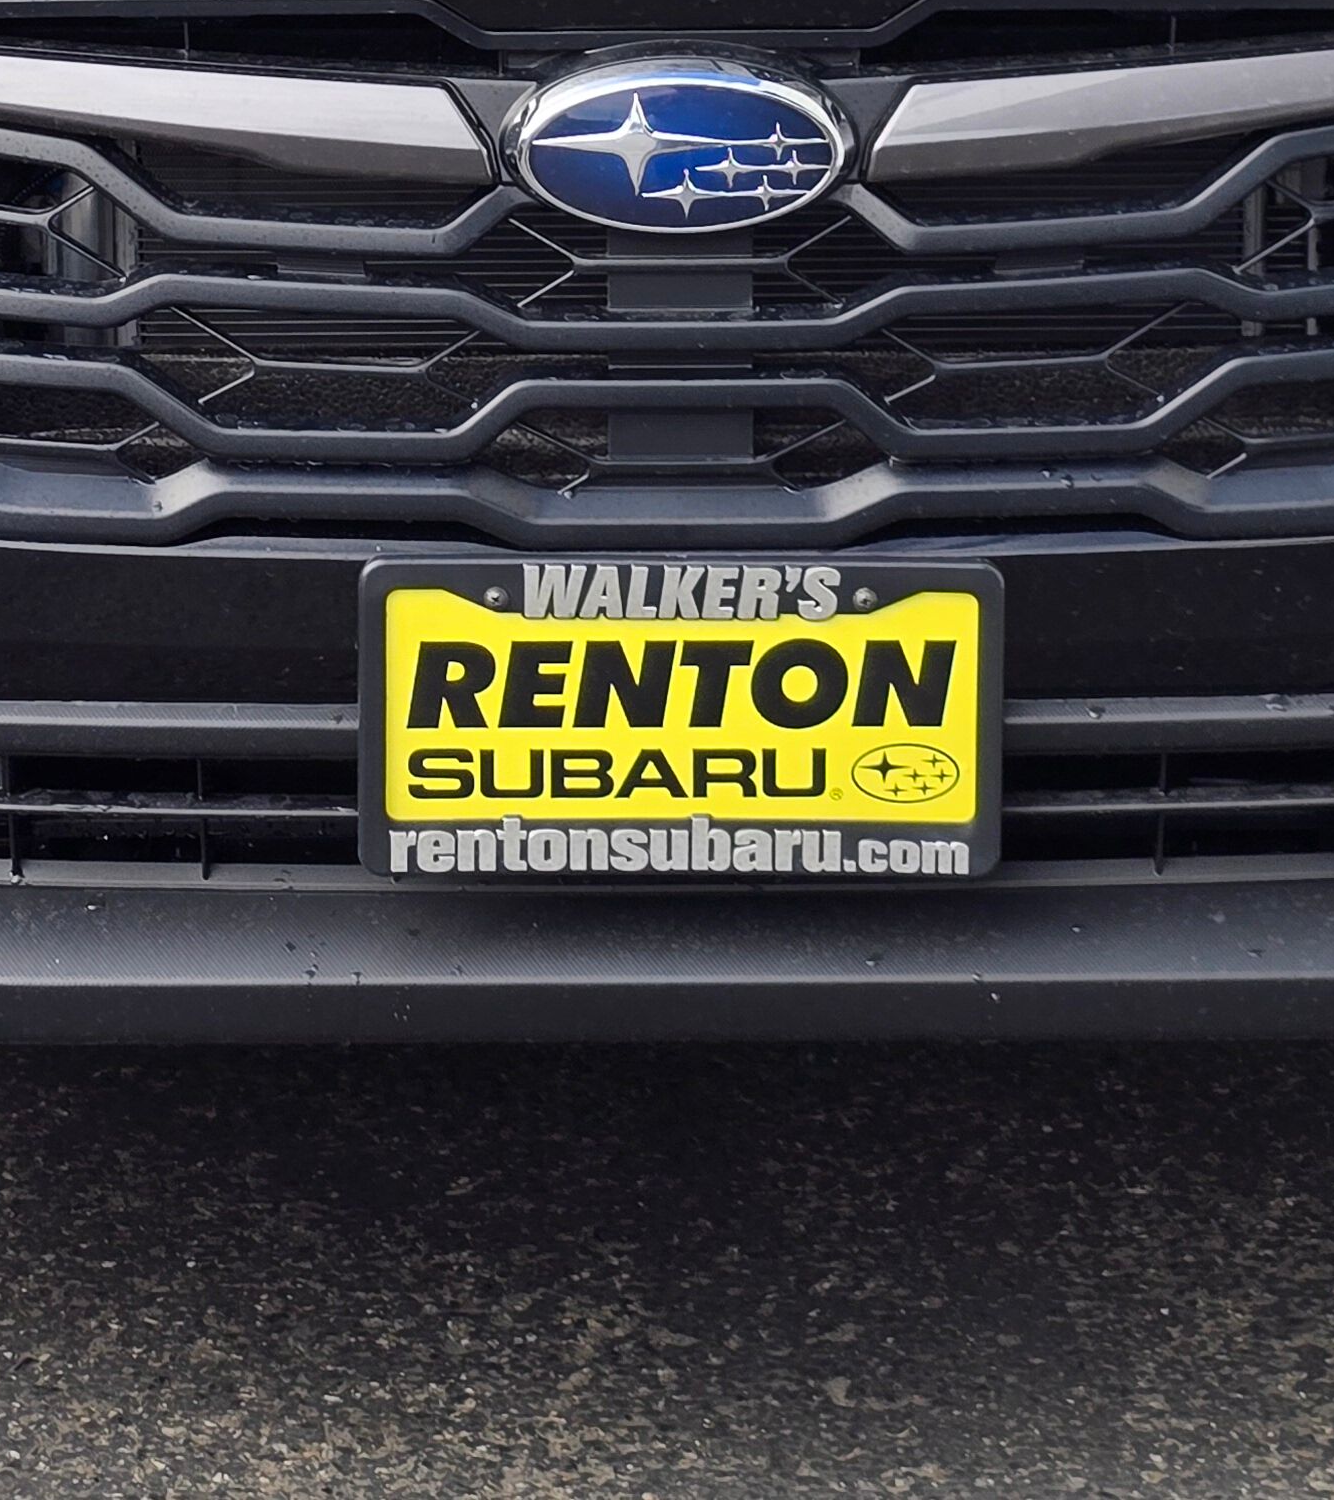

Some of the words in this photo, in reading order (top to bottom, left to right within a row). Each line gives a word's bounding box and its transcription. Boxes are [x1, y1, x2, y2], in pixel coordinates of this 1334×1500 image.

[521, 563, 841, 620] WALKER'S
[407, 638, 957, 730] RENTON
[408, 748, 827, 800] SUBARU
[389, 816, 970, 875] rentonsubaru.com
